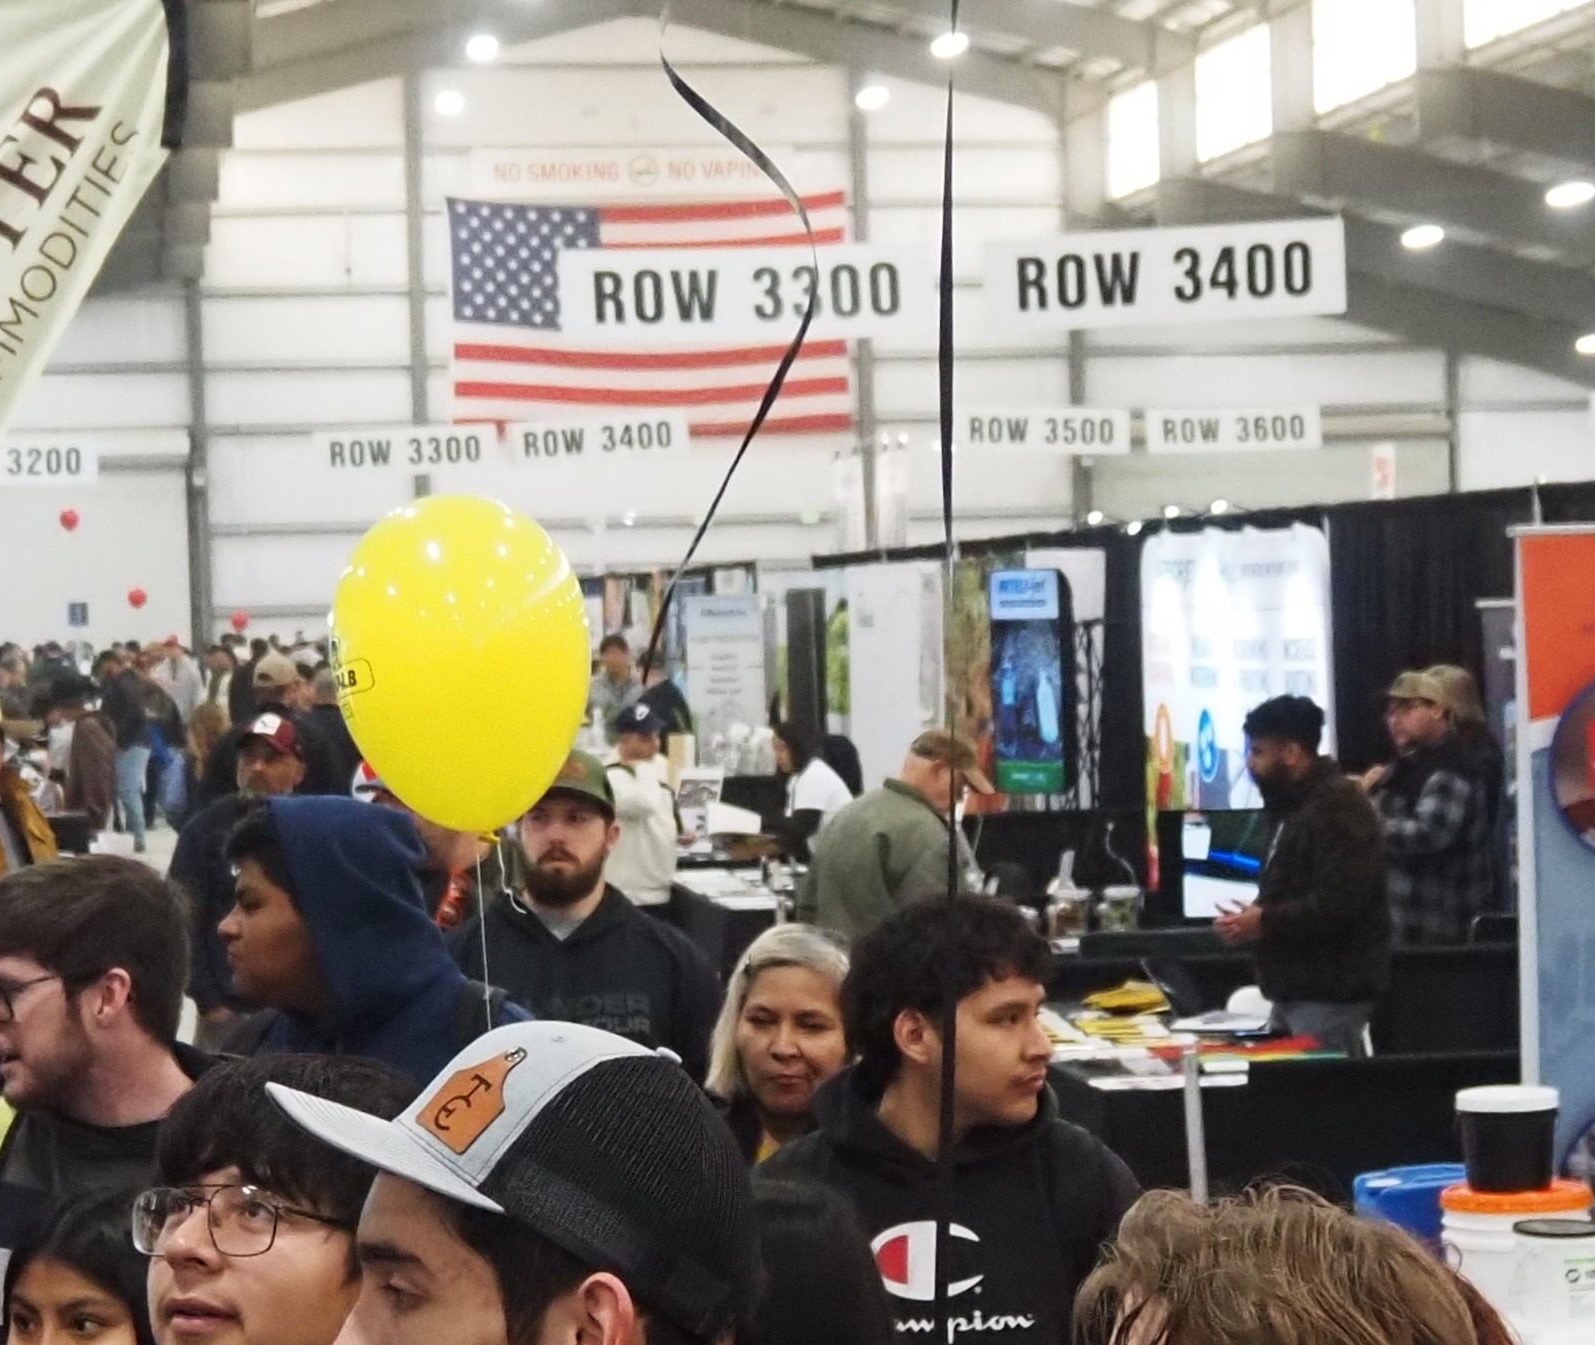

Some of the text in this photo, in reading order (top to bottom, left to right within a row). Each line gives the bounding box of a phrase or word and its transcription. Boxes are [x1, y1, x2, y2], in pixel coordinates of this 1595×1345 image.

[493, 162, 620, 182] NO SMOKING
[668, 161, 760, 180] NO VAPIN
[1017, 241, 1312, 312] ROW 3400
[592, 262, 901, 324] ROW 3300
[523, 421, 673, 458] ROW 3400
[969, 416, 1114, 445] ROW 3500
[1162, 415, 1305, 444] ROW 3600
[8, 447, 81, 476] 3200
[330, 435, 482, 468] ROW 3300
